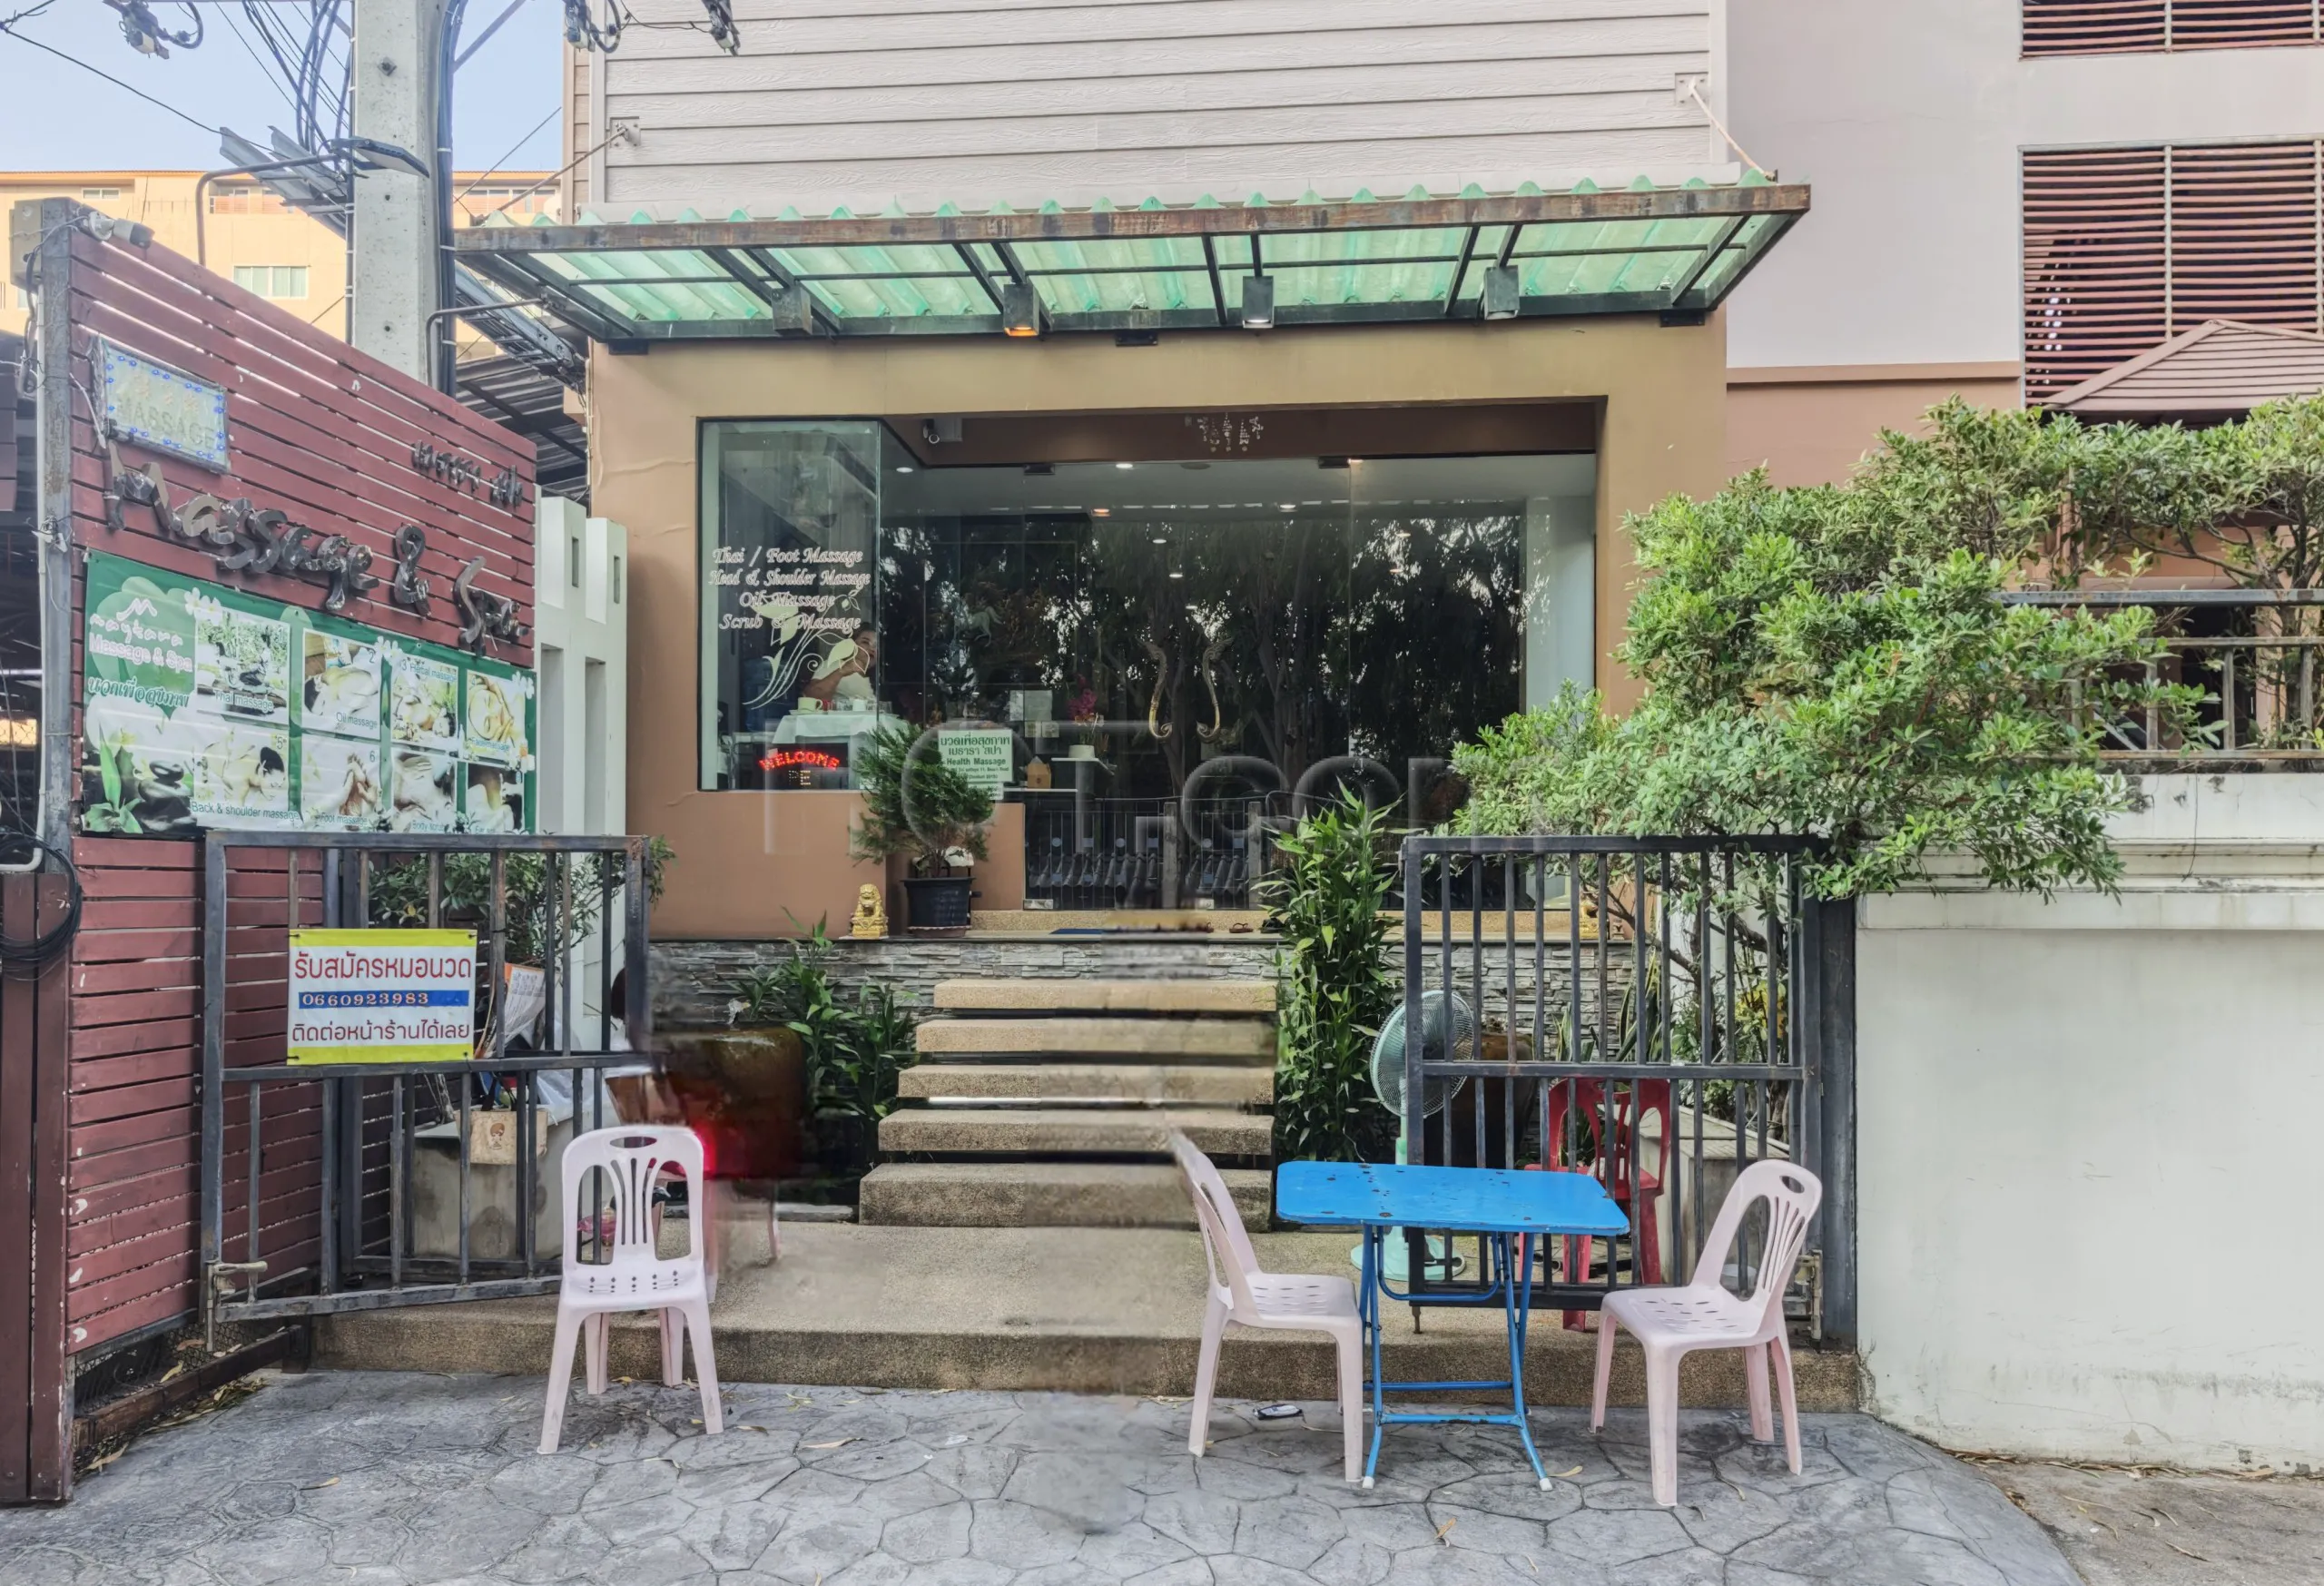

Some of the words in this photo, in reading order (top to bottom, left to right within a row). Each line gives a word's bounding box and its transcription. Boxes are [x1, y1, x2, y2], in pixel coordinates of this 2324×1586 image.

[103, 438, 379, 612] Massage
[393, 523, 432, 617] &
[454, 556, 529, 657] Spa
[713, 547, 745, 564] Thai
[766, 547, 801, 564] Foot
[802, 547, 863, 567] Massage
[708, 567, 743, 586] Head
[745, 568, 761, 586] &
[763, 567, 816, 586] Shoulder
[819, 569, 872, 589] Massage
[739, 590, 767, 607] Oil
[772, 591, 836, 612] Massage
[719, 613, 763, 629] Scrub
[797, 613, 862, 634] Massage
[88, 632, 152, 665] Massage
[153, 647, 164, 666] &
[166, 650, 193, 674] Spa
[369, 648, 376, 664] 2
[401, 658, 408, 672] 3
[214, 690, 234, 705] Thai
[235, 693, 274, 714] massage
[336, 712, 347, 724] Oil
[348, 714, 378, 730] massage
[277, 736, 283, 750] 5
[940, 732, 1010, 748] นวดเพื่อสุขภาพ
[369, 750, 376, 763] 6
[759, 751, 840, 771] WELCOME
[973, 758, 1006, 767] Massage
[192, 801, 215, 813] Back
[216, 803, 223, 813] &
[225, 803, 261, 817] shoulder
[262, 809, 300, 822] massage
[294, 951, 471, 979] รับสมัครหมอนวด
[302, 992, 428, 1006] 0660923983
[291, 1019, 470, 1041] ติดต่อหน้าร้านได้เลย
